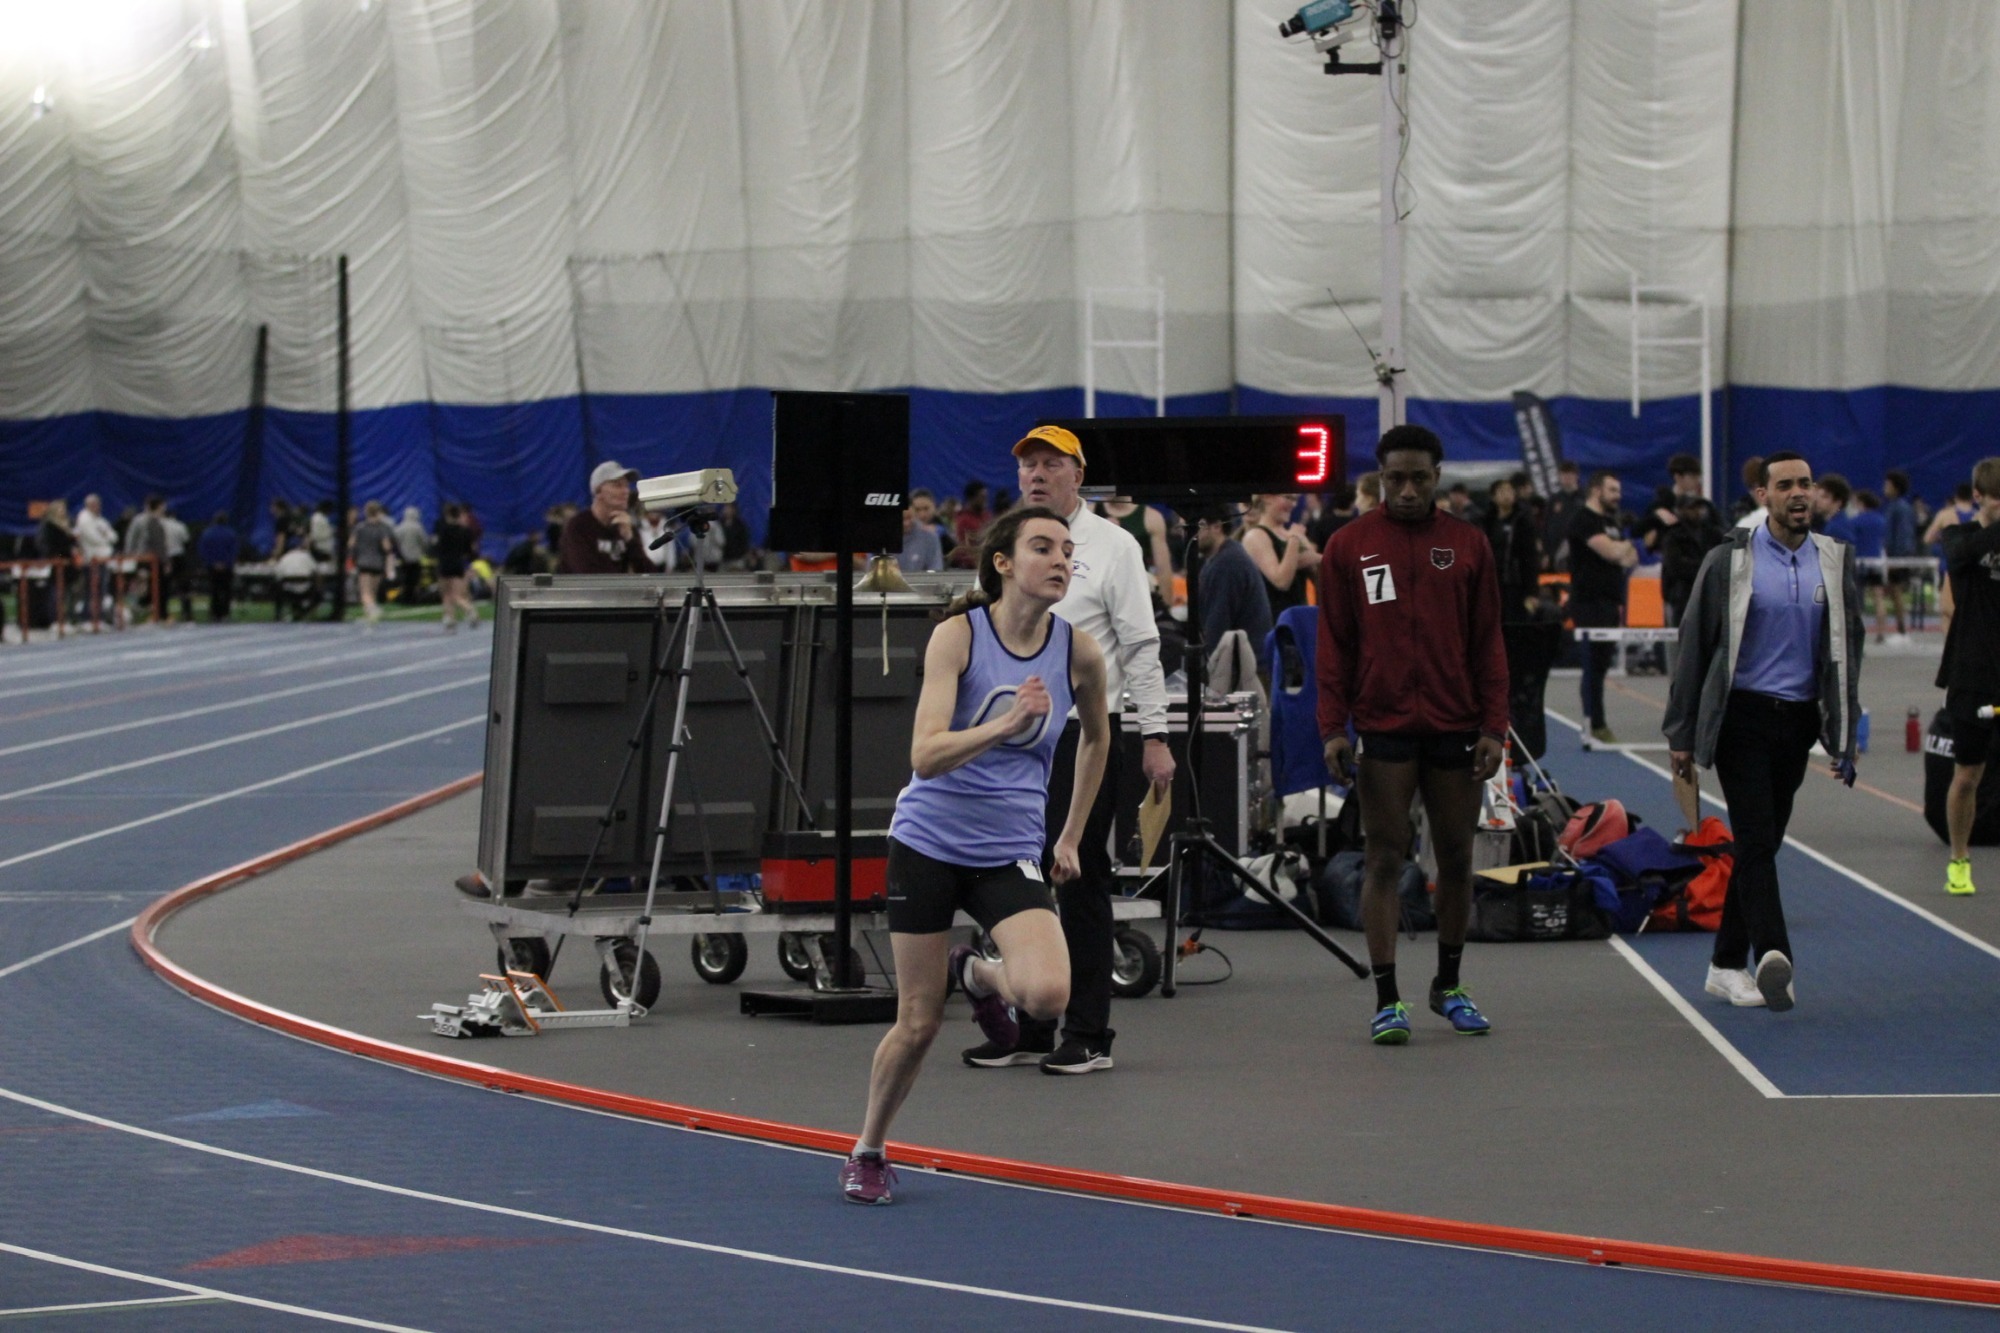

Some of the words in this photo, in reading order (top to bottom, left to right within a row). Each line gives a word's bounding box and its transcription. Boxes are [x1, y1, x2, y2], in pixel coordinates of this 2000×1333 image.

[1297, 426, 1329, 482] 3
[864, 493, 900, 506] GILL
[1367, 567, 1386, 600] 7
